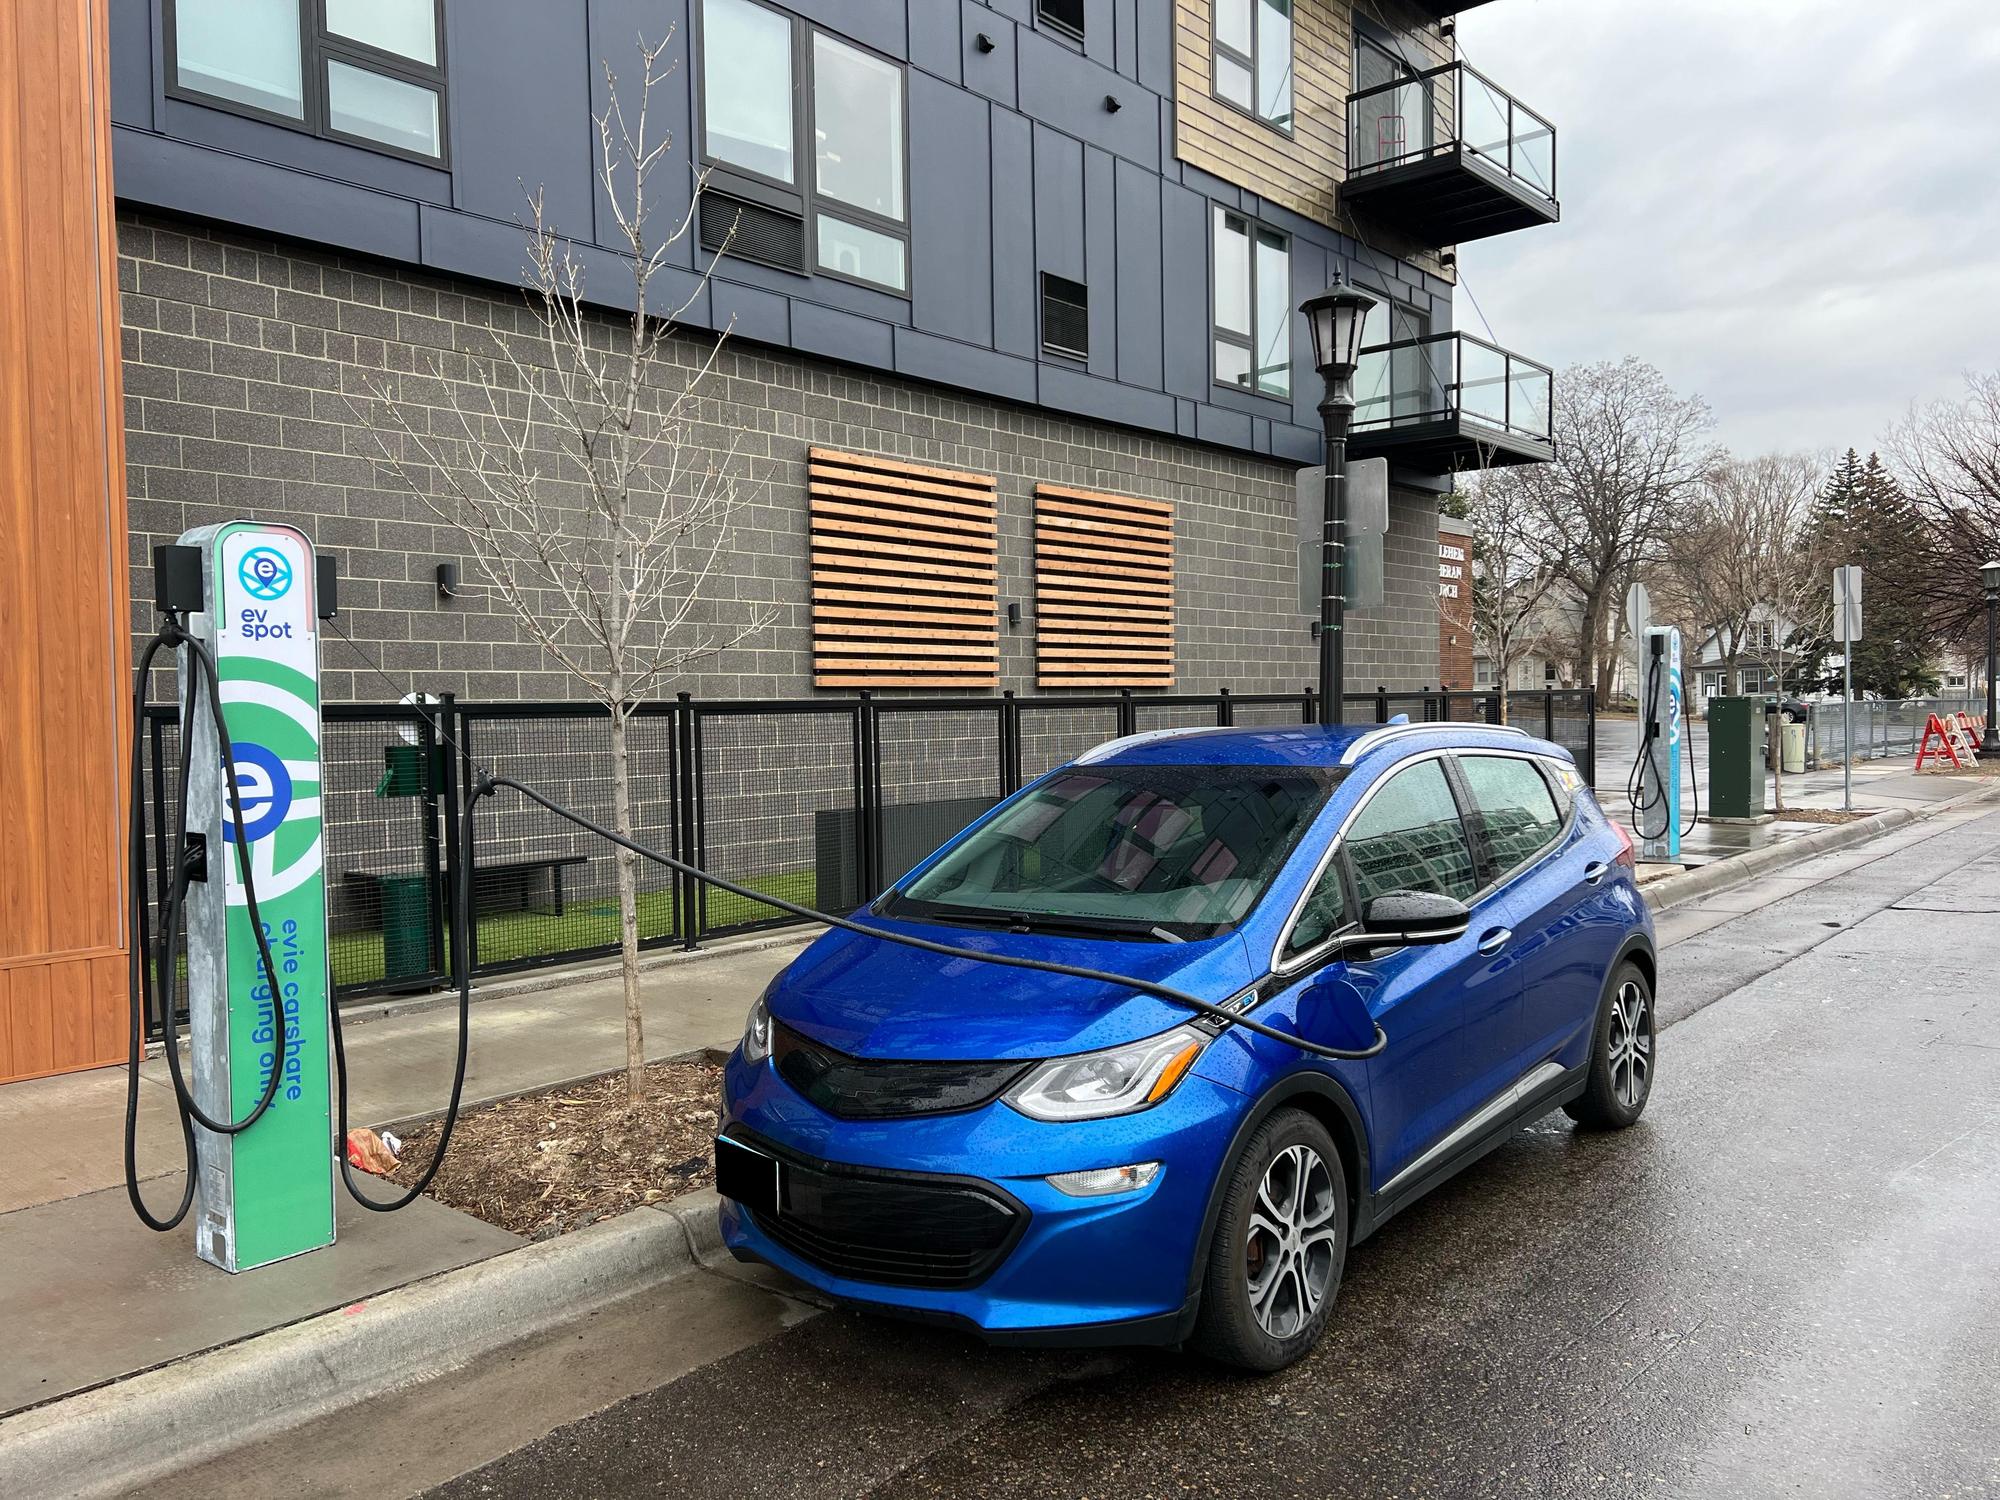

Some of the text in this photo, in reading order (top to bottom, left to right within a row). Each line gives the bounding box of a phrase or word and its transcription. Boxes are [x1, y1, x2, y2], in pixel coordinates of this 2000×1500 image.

[258, 561, 274, 578] e
[241, 608, 268, 623] ev
[241, 622, 292, 641] spot
[221, 762, 274, 824] e
[1244, 994, 1254, 1006] EV
[282, 918, 306, 1101] evie carshare
